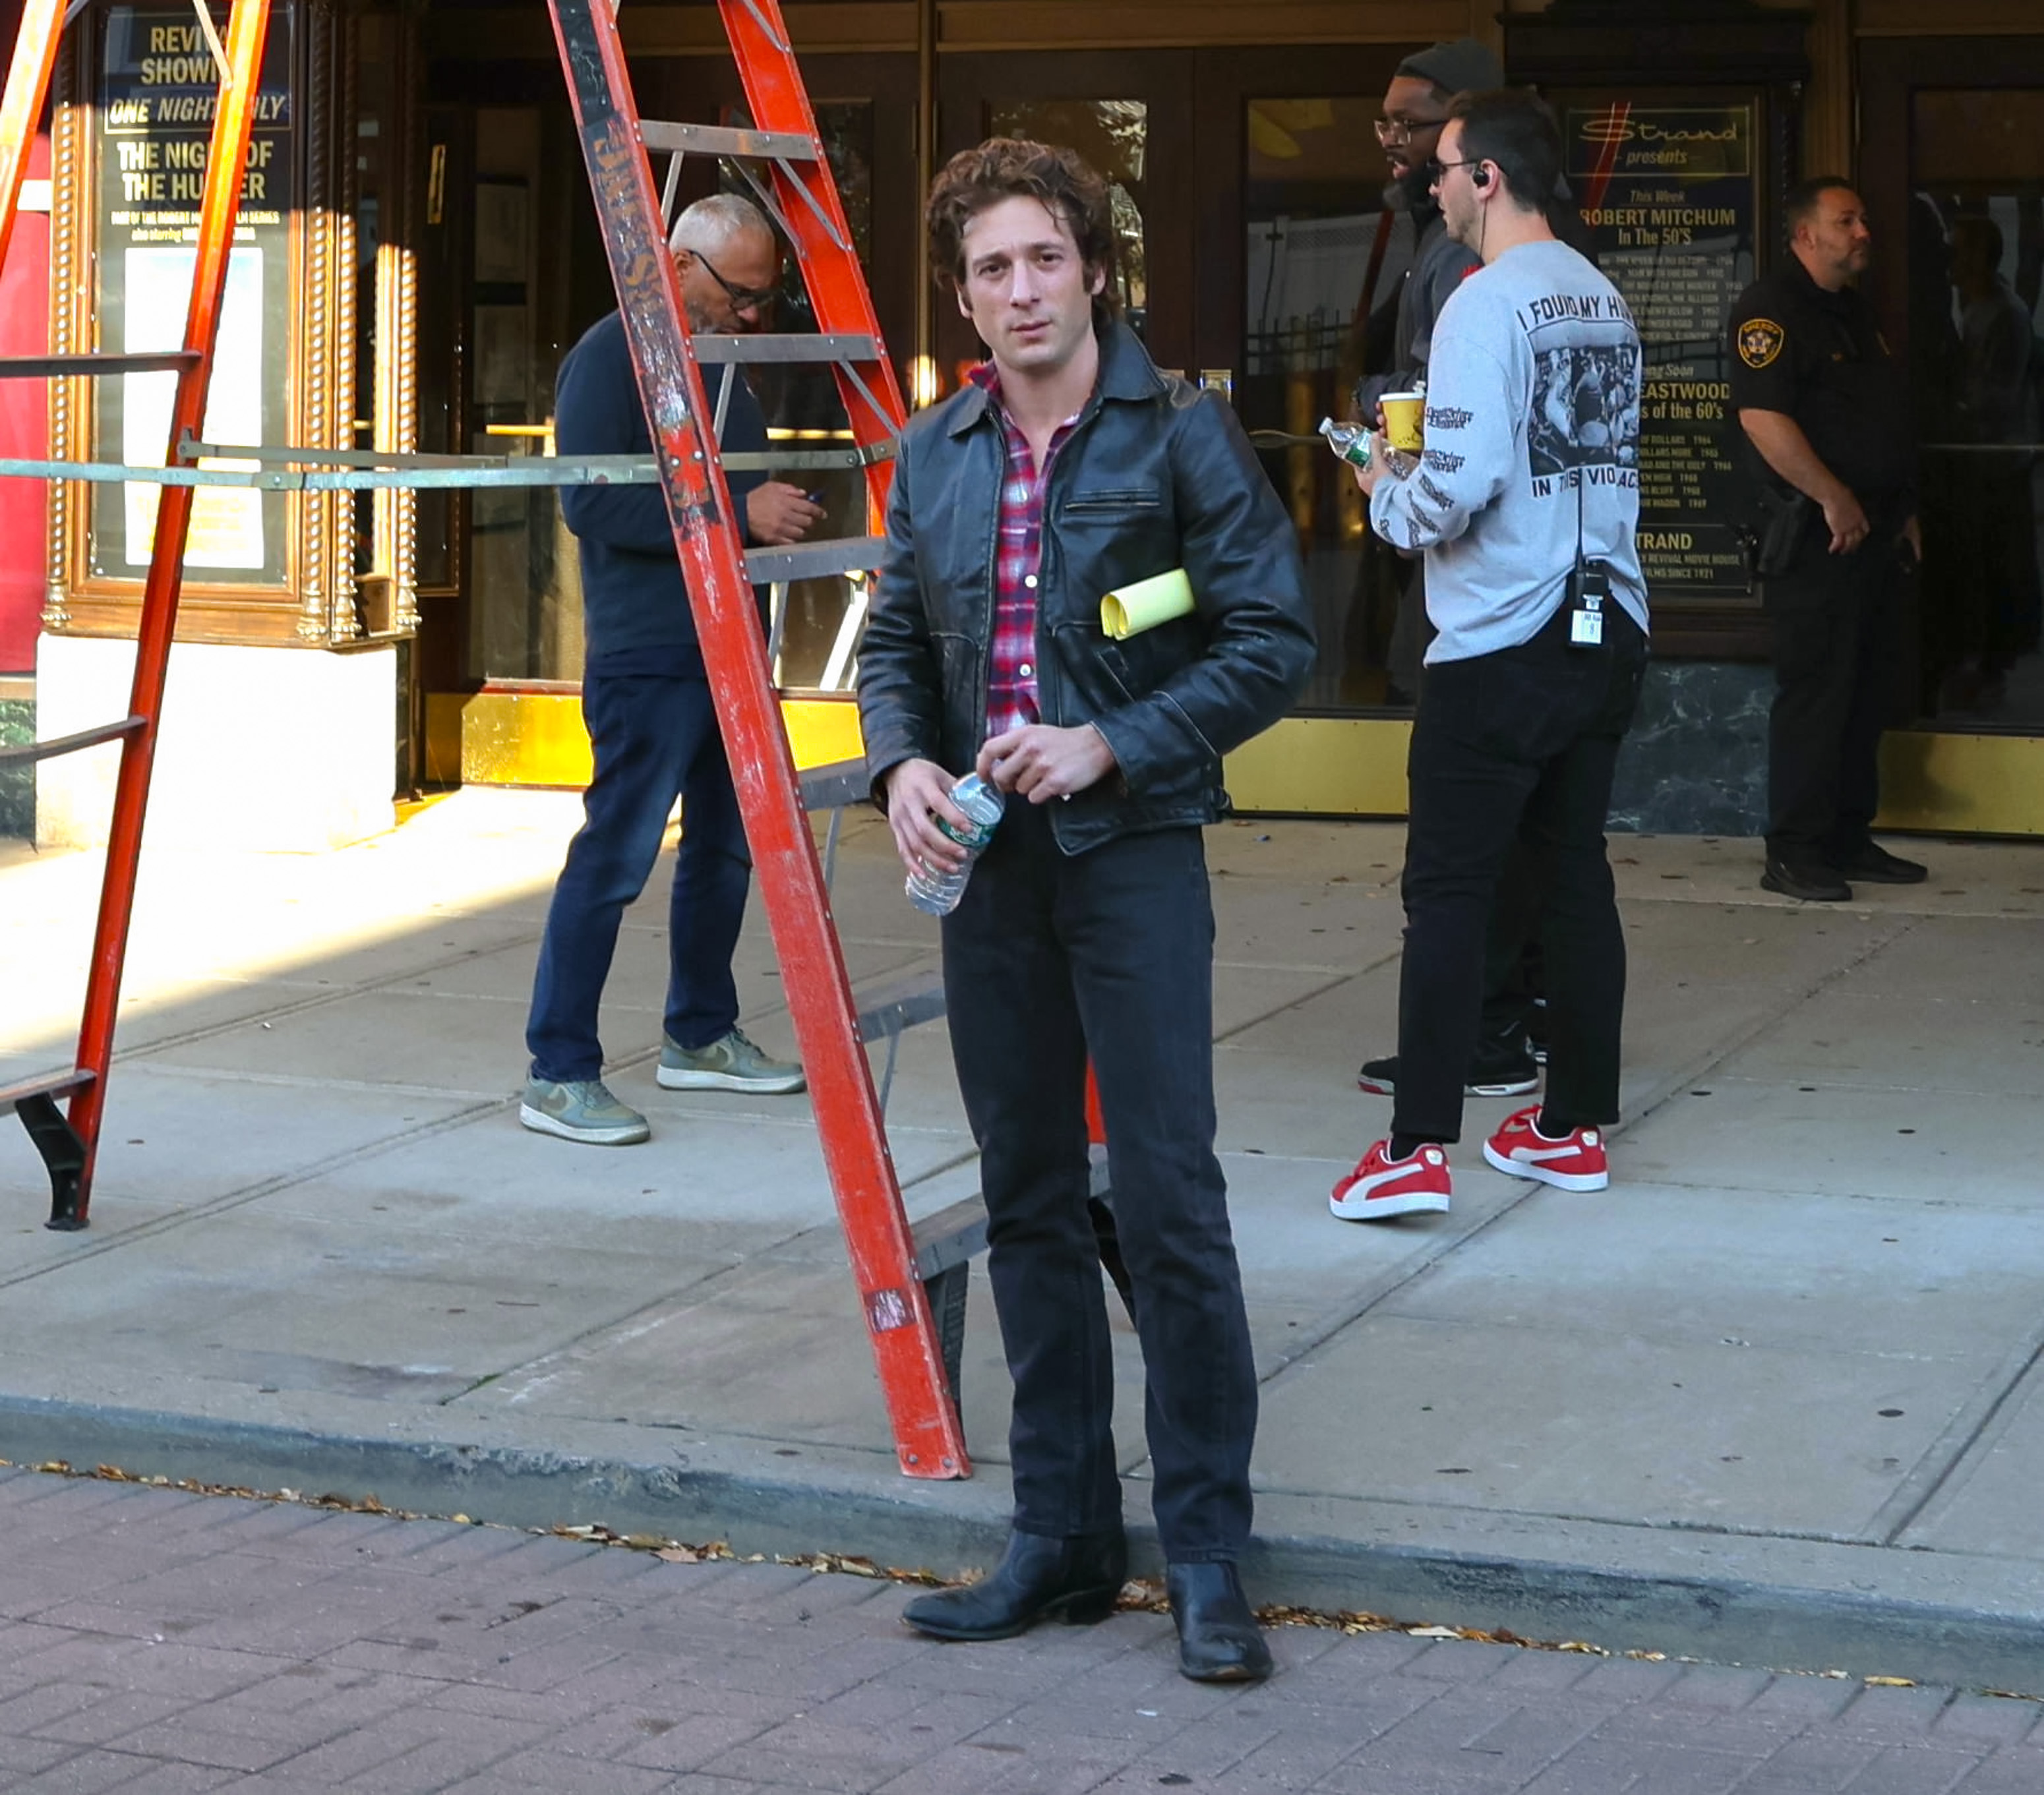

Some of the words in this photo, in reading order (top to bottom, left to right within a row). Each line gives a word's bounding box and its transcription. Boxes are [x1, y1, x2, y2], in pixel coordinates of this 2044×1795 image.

[151, 25, 228, 53] REVIA
[140, 57, 218, 84] SHOWI
[110, 98, 152, 124] ONE
[253, 95, 286, 121] LY
[1578, 119, 1737, 142] Strand
[117, 141, 160, 171] THE
[165, 141, 211, 170] NIG
[245, 140, 274, 168] OF
[1625, 148, 1689, 167] presents
[121, 172, 165, 202] THE
[171, 172, 266, 200] HUER
[1630, 189, 1652, 203] This
[1656, 189, 1686, 203] Week
[1580, 208, 1647, 225] ROBERT
[1651, 208, 1735, 225] MITCHUM
[1617, 228, 1631, 245] In
[1636, 228, 1658, 245] The
[1516, 310, 1528, 331] I
[1580, 295, 1600, 318] MY
[1666, 363, 1694, 378] Soon
[1652, 401, 1667, 419] of
[1671, 401, 1693, 419] the
[1696, 401, 1724, 419] 60's
[1532, 478, 1551, 497] IN
[1587, 467, 1616, 485] VIO
[1637, 532, 1693, 550] TRAND
